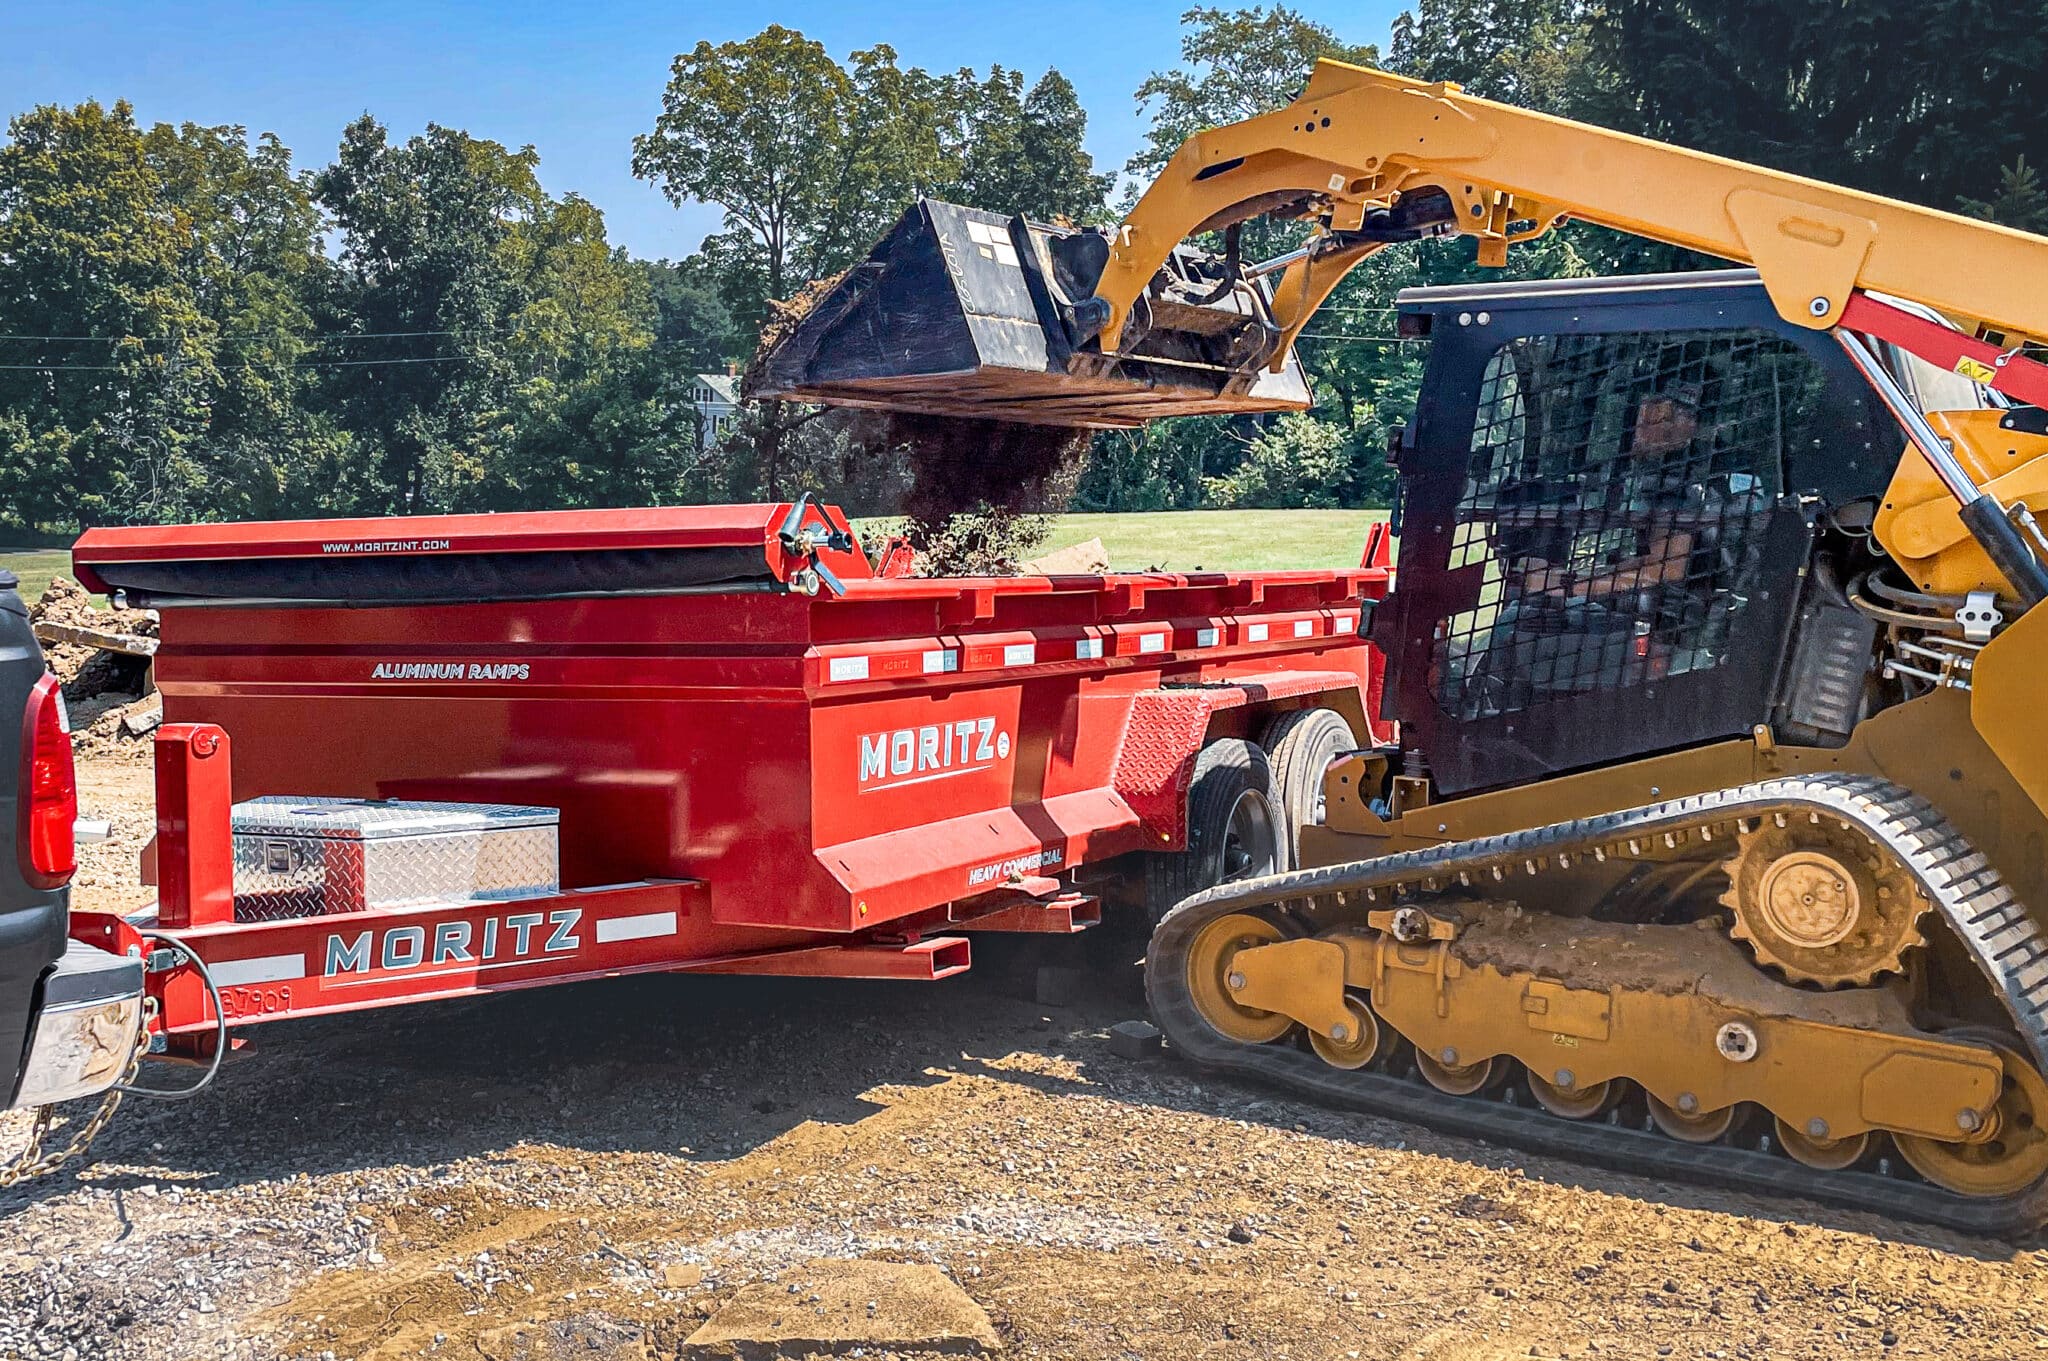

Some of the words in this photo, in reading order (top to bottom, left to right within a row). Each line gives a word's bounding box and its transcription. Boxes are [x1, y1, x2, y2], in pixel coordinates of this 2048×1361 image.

[322, 540, 450, 553] WWW.MORITZINT.COM
[371, 663, 465, 679] ALUMINUM
[468, 664, 530, 680] RAMPS
[860, 717, 996, 782] MORITZ
[968, 863, 1002, 886] HEAVY
[1003, 848, 1062, 876] COMMERCIAL
[324, 908, 583, 978] MORITZ
